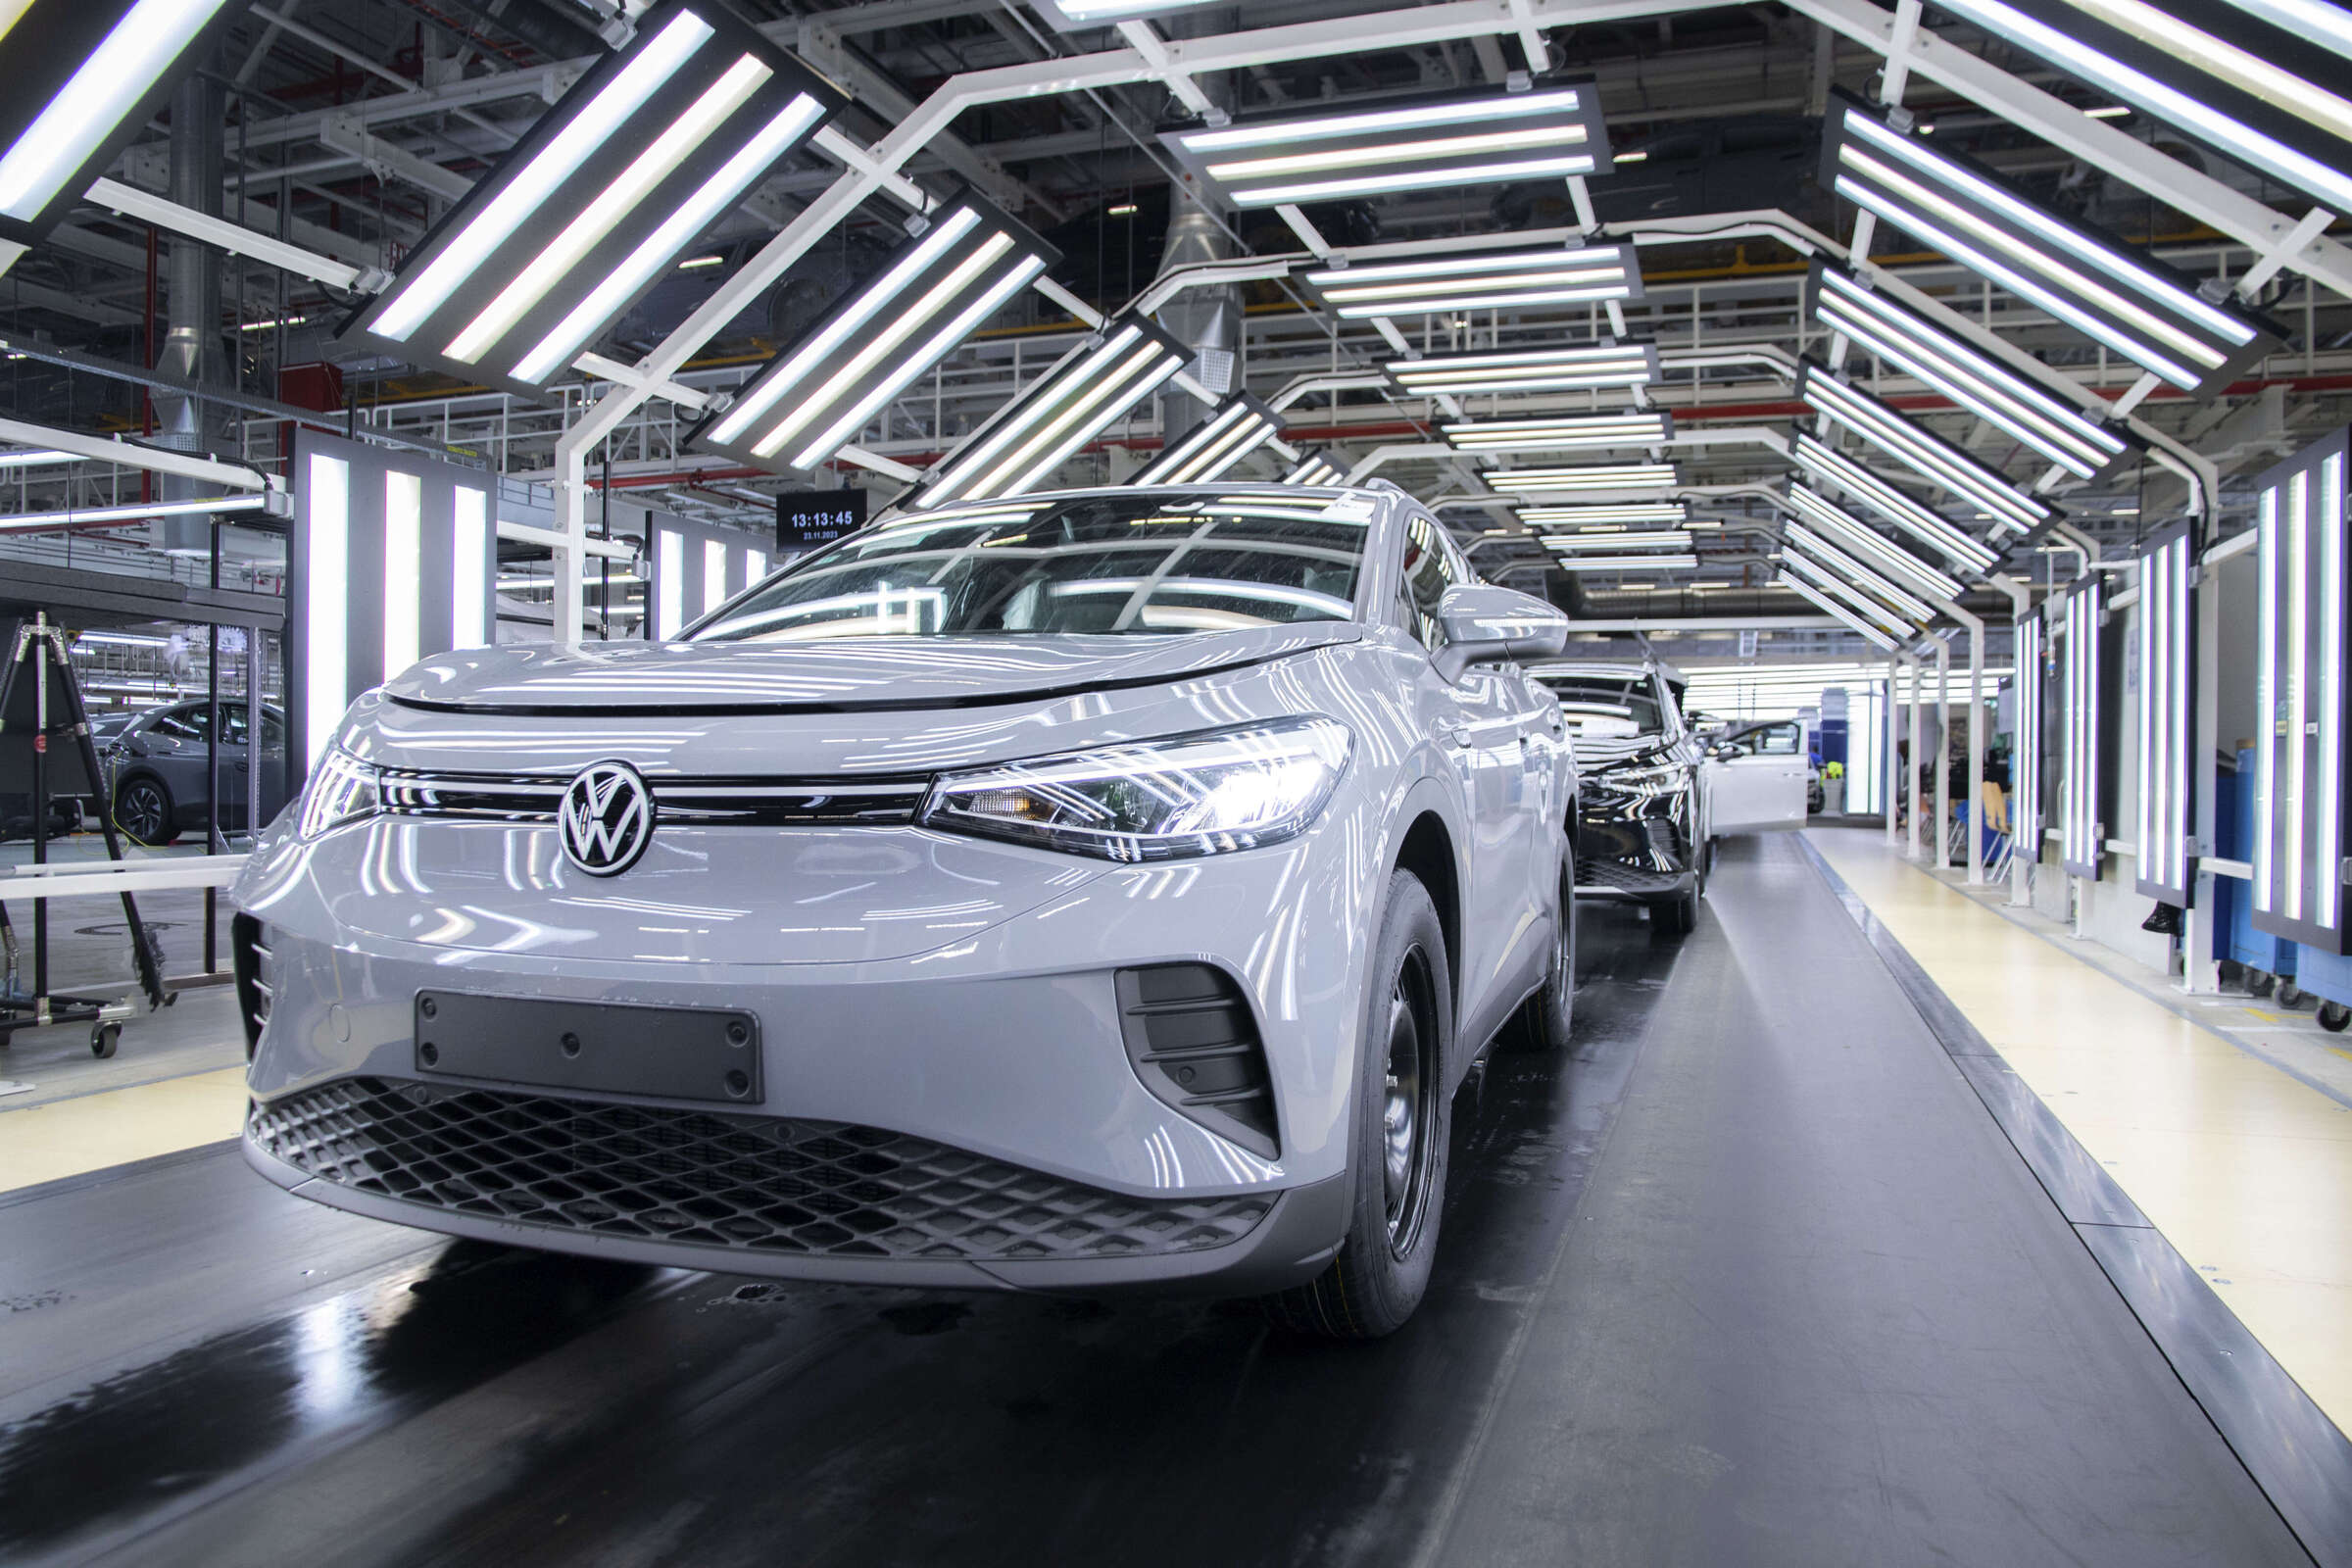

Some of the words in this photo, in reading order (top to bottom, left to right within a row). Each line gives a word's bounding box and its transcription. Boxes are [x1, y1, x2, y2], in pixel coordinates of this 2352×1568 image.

[792, 511, 853, 527] 13:13:45
[804, 530, 838, 540] 23.11.2023
[563, 765, 646, 868] VW
